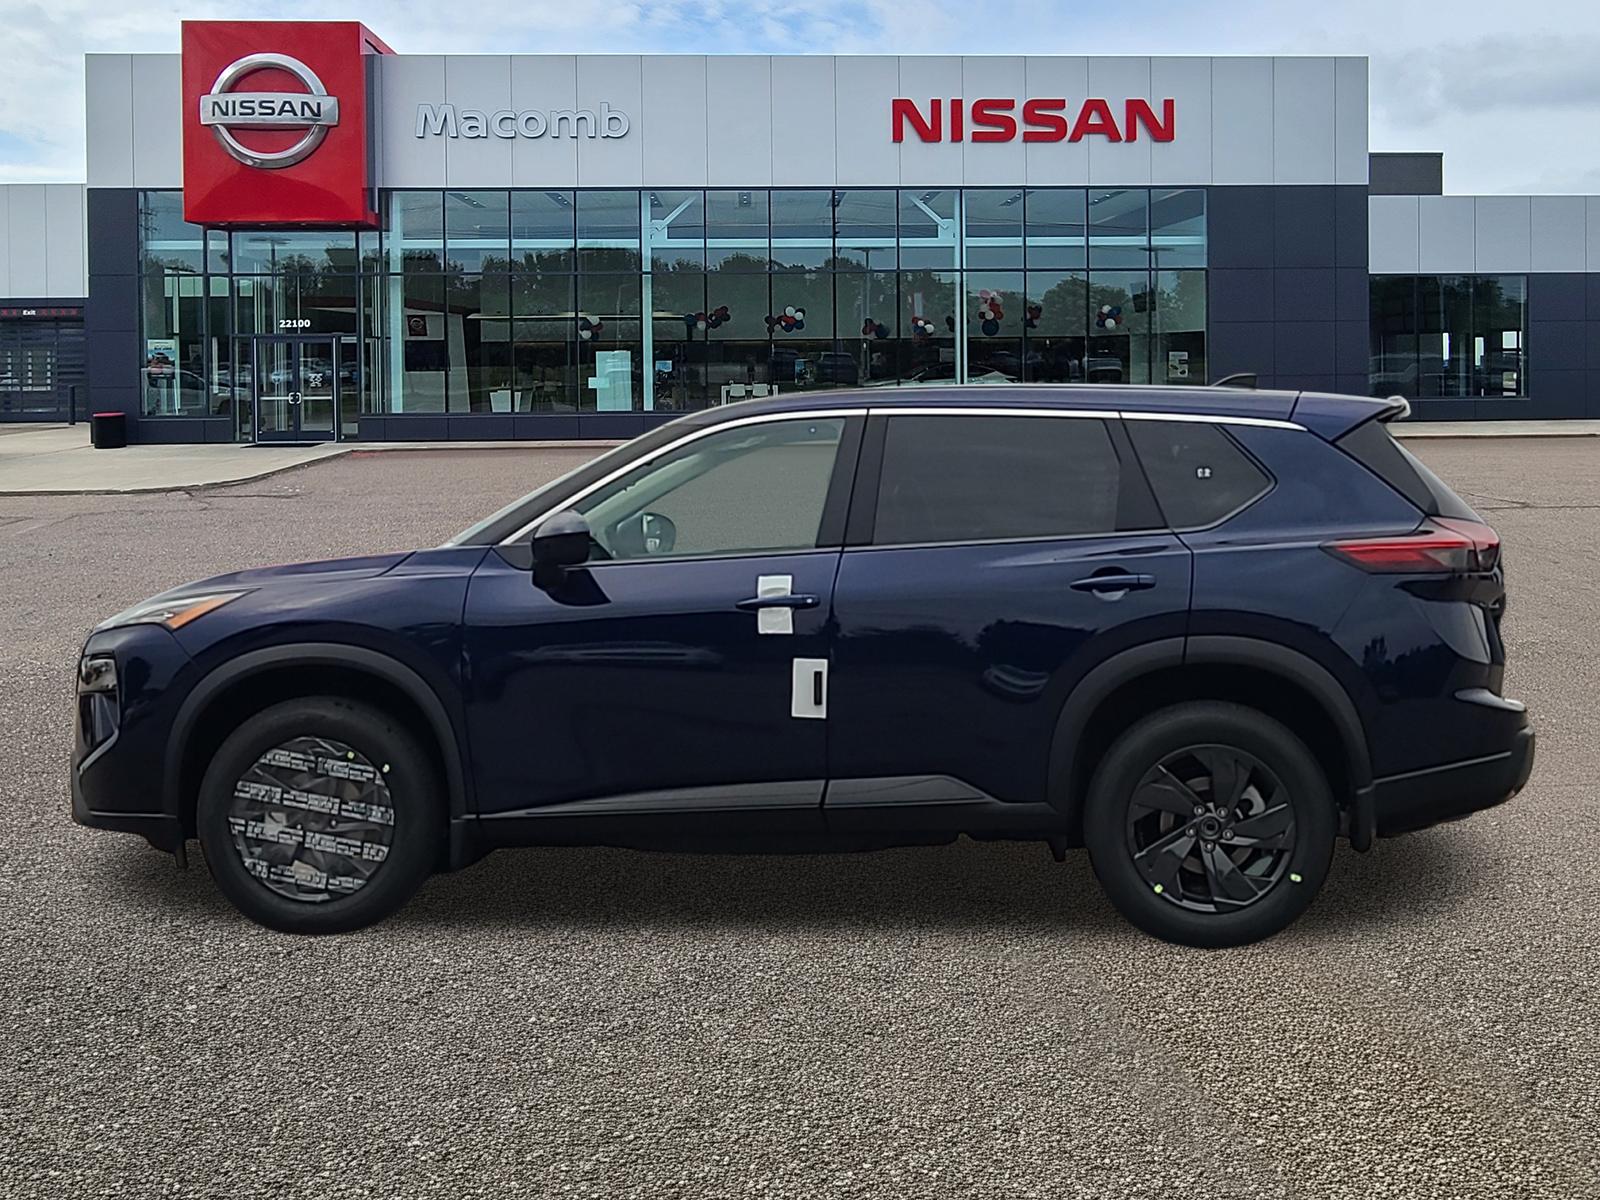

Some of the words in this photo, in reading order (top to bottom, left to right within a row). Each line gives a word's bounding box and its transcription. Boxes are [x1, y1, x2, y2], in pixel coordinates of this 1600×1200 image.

[212, 100, 322, 117] NISSAN
[415, 102, 630, 138] Macomb
[892, 99, 1175, 142] NISSAN
[279, 319, 311, 328] 22100
